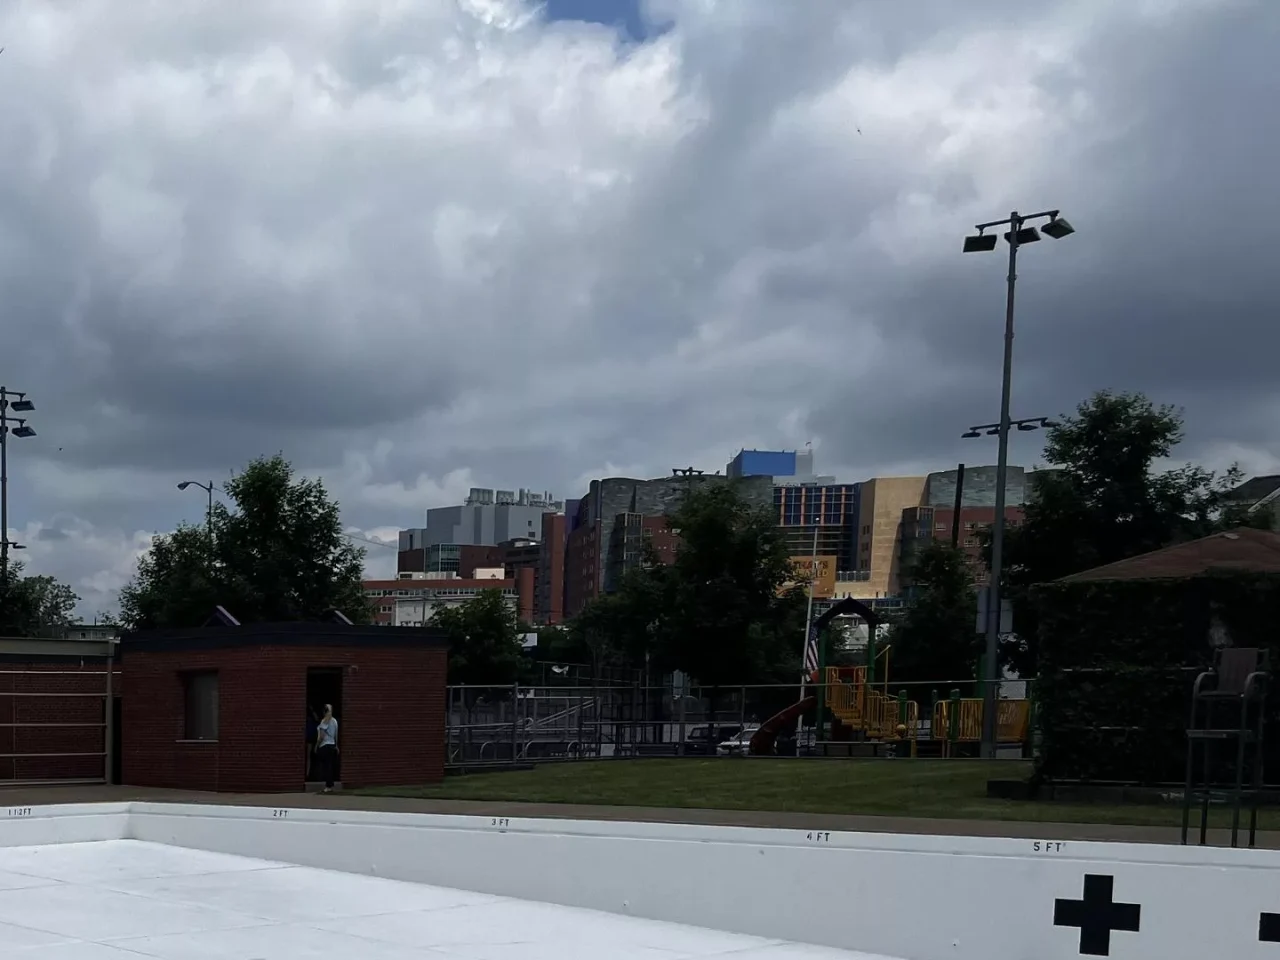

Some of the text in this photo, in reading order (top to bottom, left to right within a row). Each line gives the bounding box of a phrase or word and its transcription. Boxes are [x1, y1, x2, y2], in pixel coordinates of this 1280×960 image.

[491, 818, 510, 827] 3 FT
[816, 832, 831, 842] FT
[1033, 841, 1041, 852] 5
